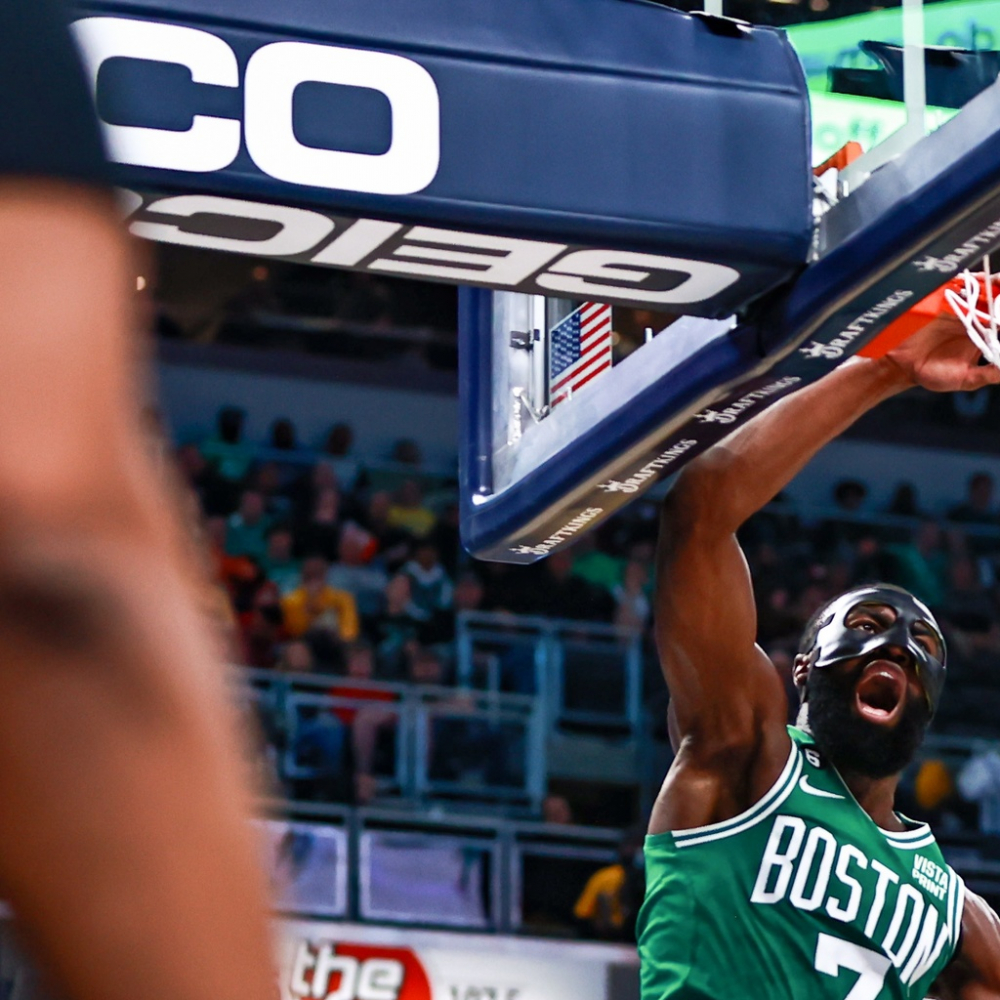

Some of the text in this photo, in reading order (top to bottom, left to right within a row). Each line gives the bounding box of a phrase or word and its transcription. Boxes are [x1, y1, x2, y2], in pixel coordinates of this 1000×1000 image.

[113, 187, 741, 304] GEIC
[820, 289, 914, 359] DRAFTKINGS
[715, 375, 801, 424] DRAFTKINGS
[618, 438, 698, 493] DRAFTKINGS
[531, 506, 603, 555] DRAFTKINGS
[911, 867, 948, 901] PRINT
[914, 853, 949, 891] VISTA
[750, 814, 950, 988] BOSTON
